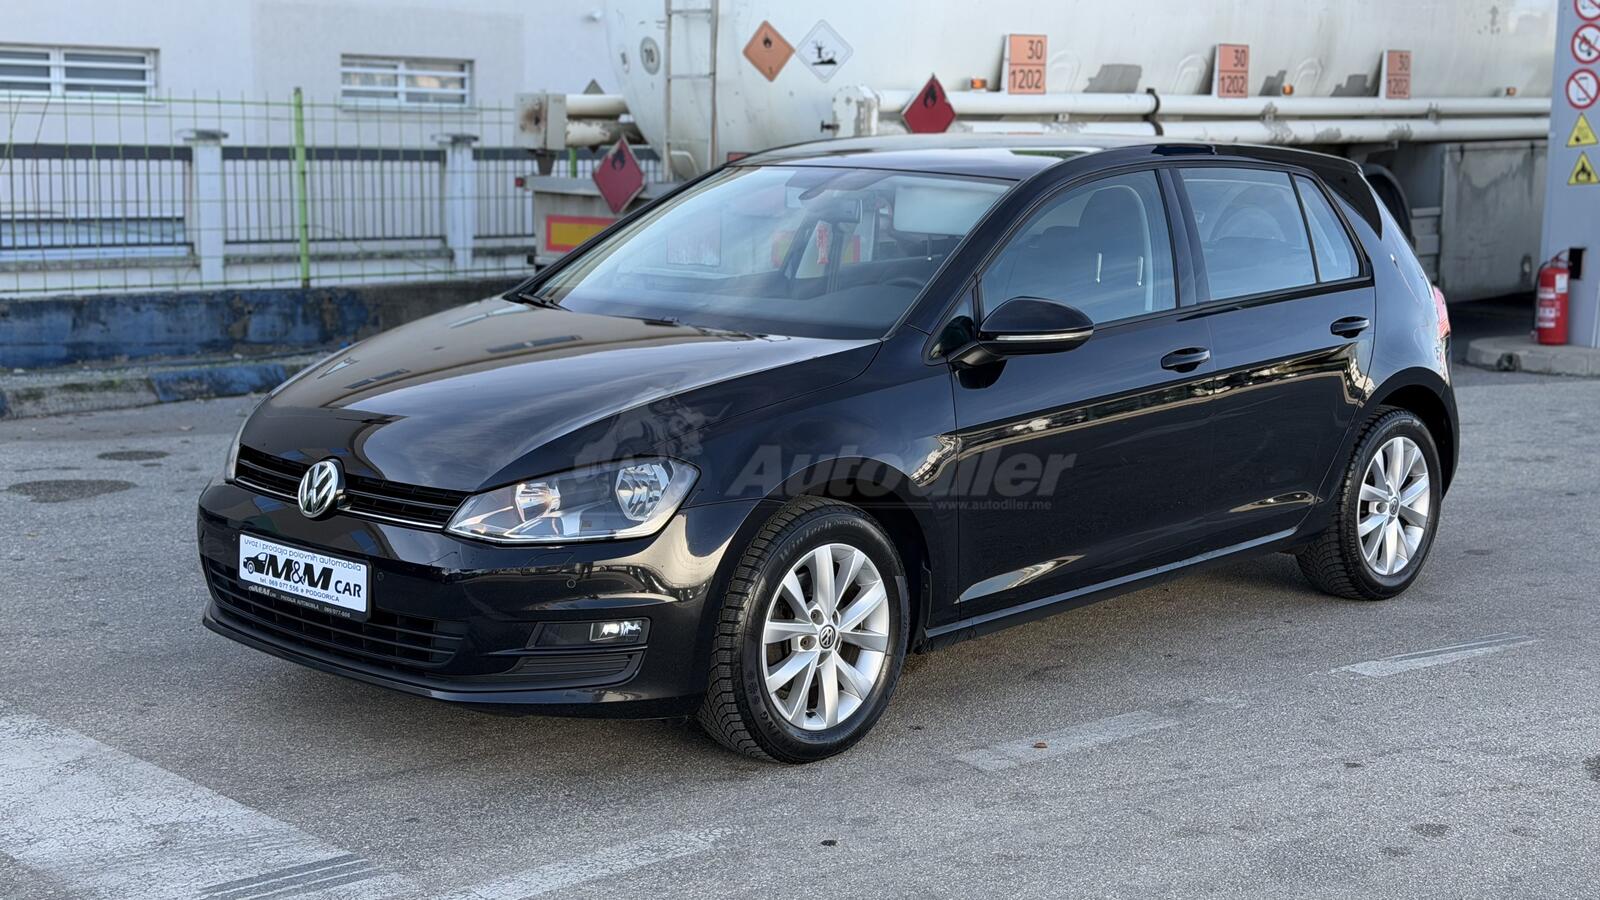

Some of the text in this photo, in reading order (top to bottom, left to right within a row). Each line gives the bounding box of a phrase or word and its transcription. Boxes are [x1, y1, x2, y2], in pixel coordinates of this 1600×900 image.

[1027, 39, 1044, 60] 30
[1233, 49, 1247, 68] 30
[1010, 68, 1042, 89] 1202
[1221, 75, 1246, 94] 1202
[262, 543, 288, 556] prodaja
[289, 549, 318, 562] polovnih
[319, 556, 362, 571] automobila
[265, 553, 362, 598] M&M CAR
[279, 582, 288, 590] 077
[306, 588, 340, 603] PODGORICA
